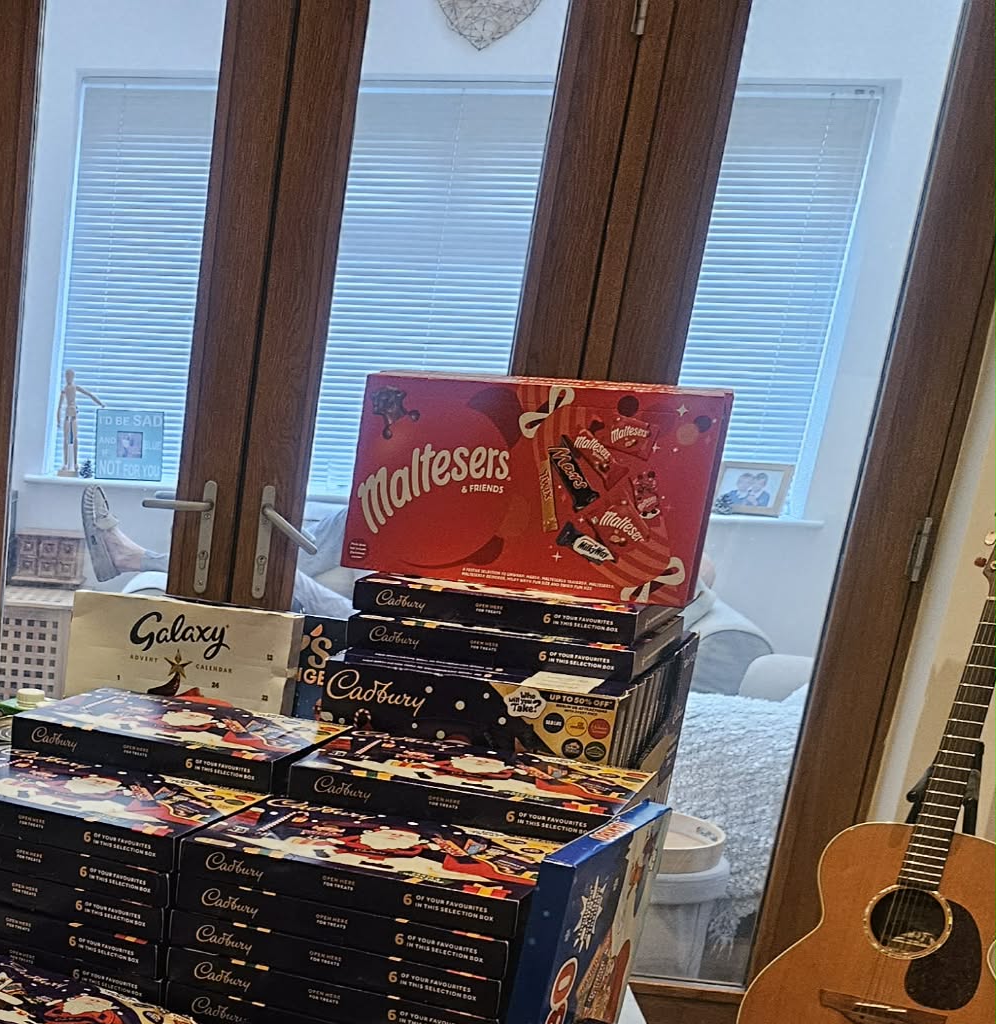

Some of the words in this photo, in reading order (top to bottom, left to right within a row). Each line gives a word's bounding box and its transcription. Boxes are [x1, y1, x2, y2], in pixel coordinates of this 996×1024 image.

[116, 416, 130, 426] BE
[133, 415, 162, 427] SAD
[611, 426, 650, 443] Maltesers
[99, 460, 122, 476] NOT
[124, 464, 140, 476] FOR
[142, 465, 160, 477] YOU
[549, 447, 588, 490] Mars
[358, 444, 509, 534] Maltesers
[460, 485, 468, 494] &
[469, 484, 504, 494] FRIENDS
[376, 590, 426, 612] Cadbury
[130, 612, 230, 660] Galaxy
[369, 626, 420, 649] Cadbury
[130, 654, 158, 663] ADVENT
[195, 664, 233, 674] CALENDAR
[539, 651, 546, 661] 6
[570, 660, 602, 668] SELECTION
[575, 655, 610, 664] FAVOURITES
[326, 669, 426, 717] Cadbury
[31, 726, 78, 751] Cadbury
[314, 776, 372, 803] Cadbury
[506, 811, 515, 822] 6
[547, 816, 588, 828] FAVOURITES
[541, 823, 577, 833] SELECTION
[84, 832, 91, 842] 6
[102, 834, 116, 842] YOUR
[118, 838, 151, 850] FAVOURITES
[113, 844, 144, 854] SELECTION
[206, 851, 264, 881] Cadbury
[202, 888, 260, 918] Cadbury
[404, 894, 412, 906] 6
[446, 901, 488, 913] FAVOURITES
[440, 906, 478, 918] SELECTION
[196, 924, 252, 955] Cadbury
[194, 961, 250, 992] Cadbury
